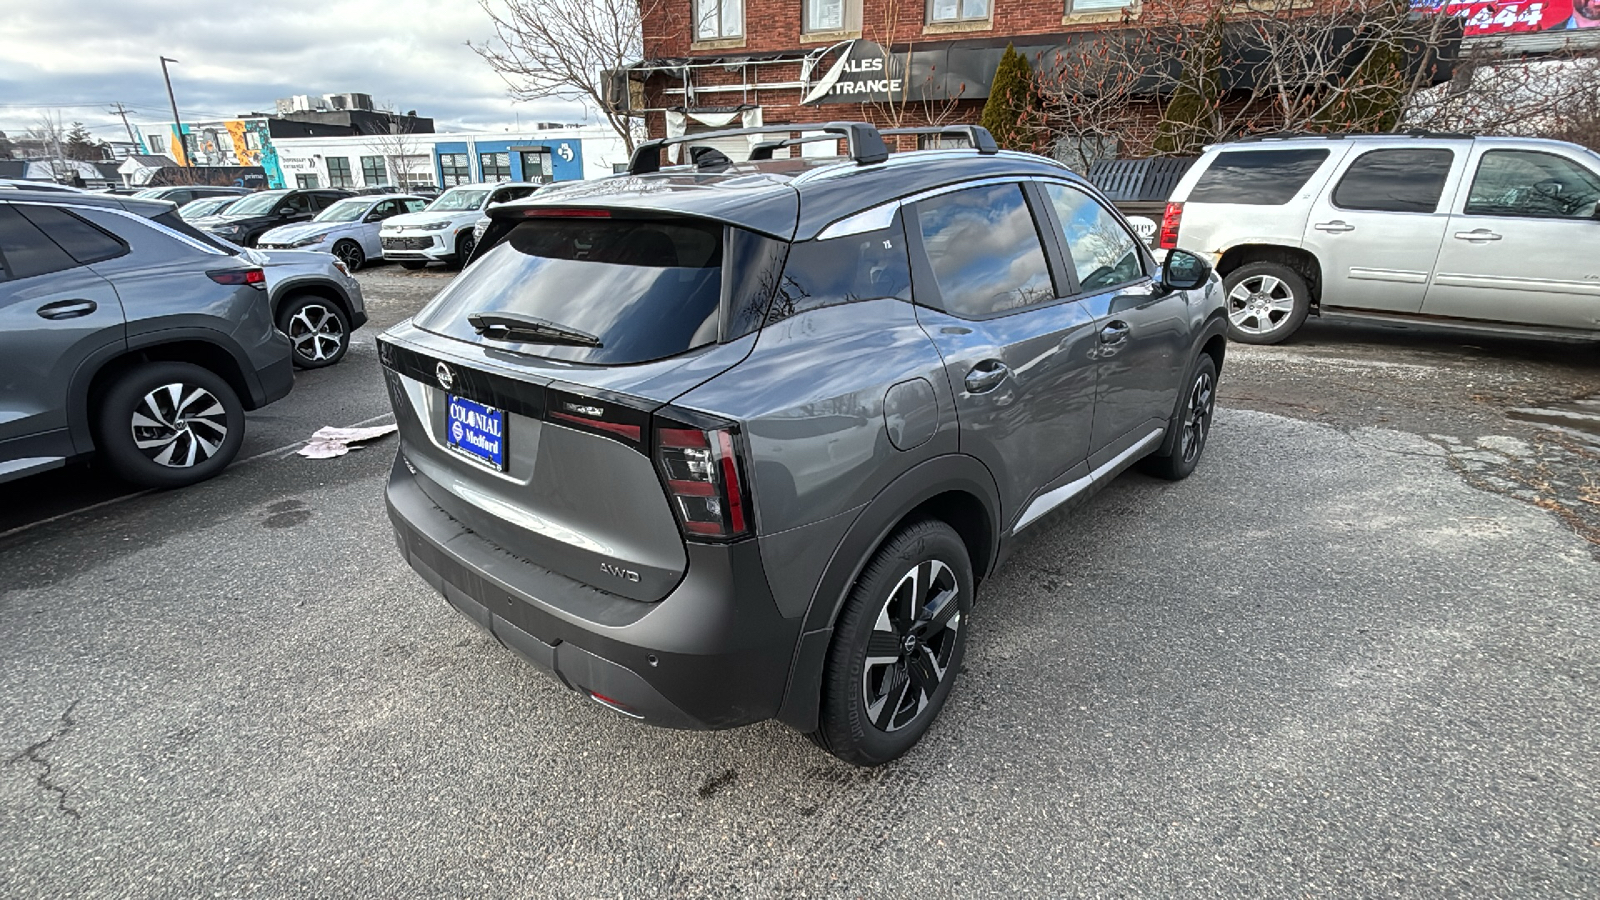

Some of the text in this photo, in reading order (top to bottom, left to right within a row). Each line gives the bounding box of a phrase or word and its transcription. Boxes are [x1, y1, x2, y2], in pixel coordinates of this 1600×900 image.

[842, 58, 883, 73] ALES
[829, 79, 902, 95] TRANCE
[450, 403, 501, 437] COLONIAL
[466, 428, 499, 454] Medford
[601, 562, 640, 582] AWD
